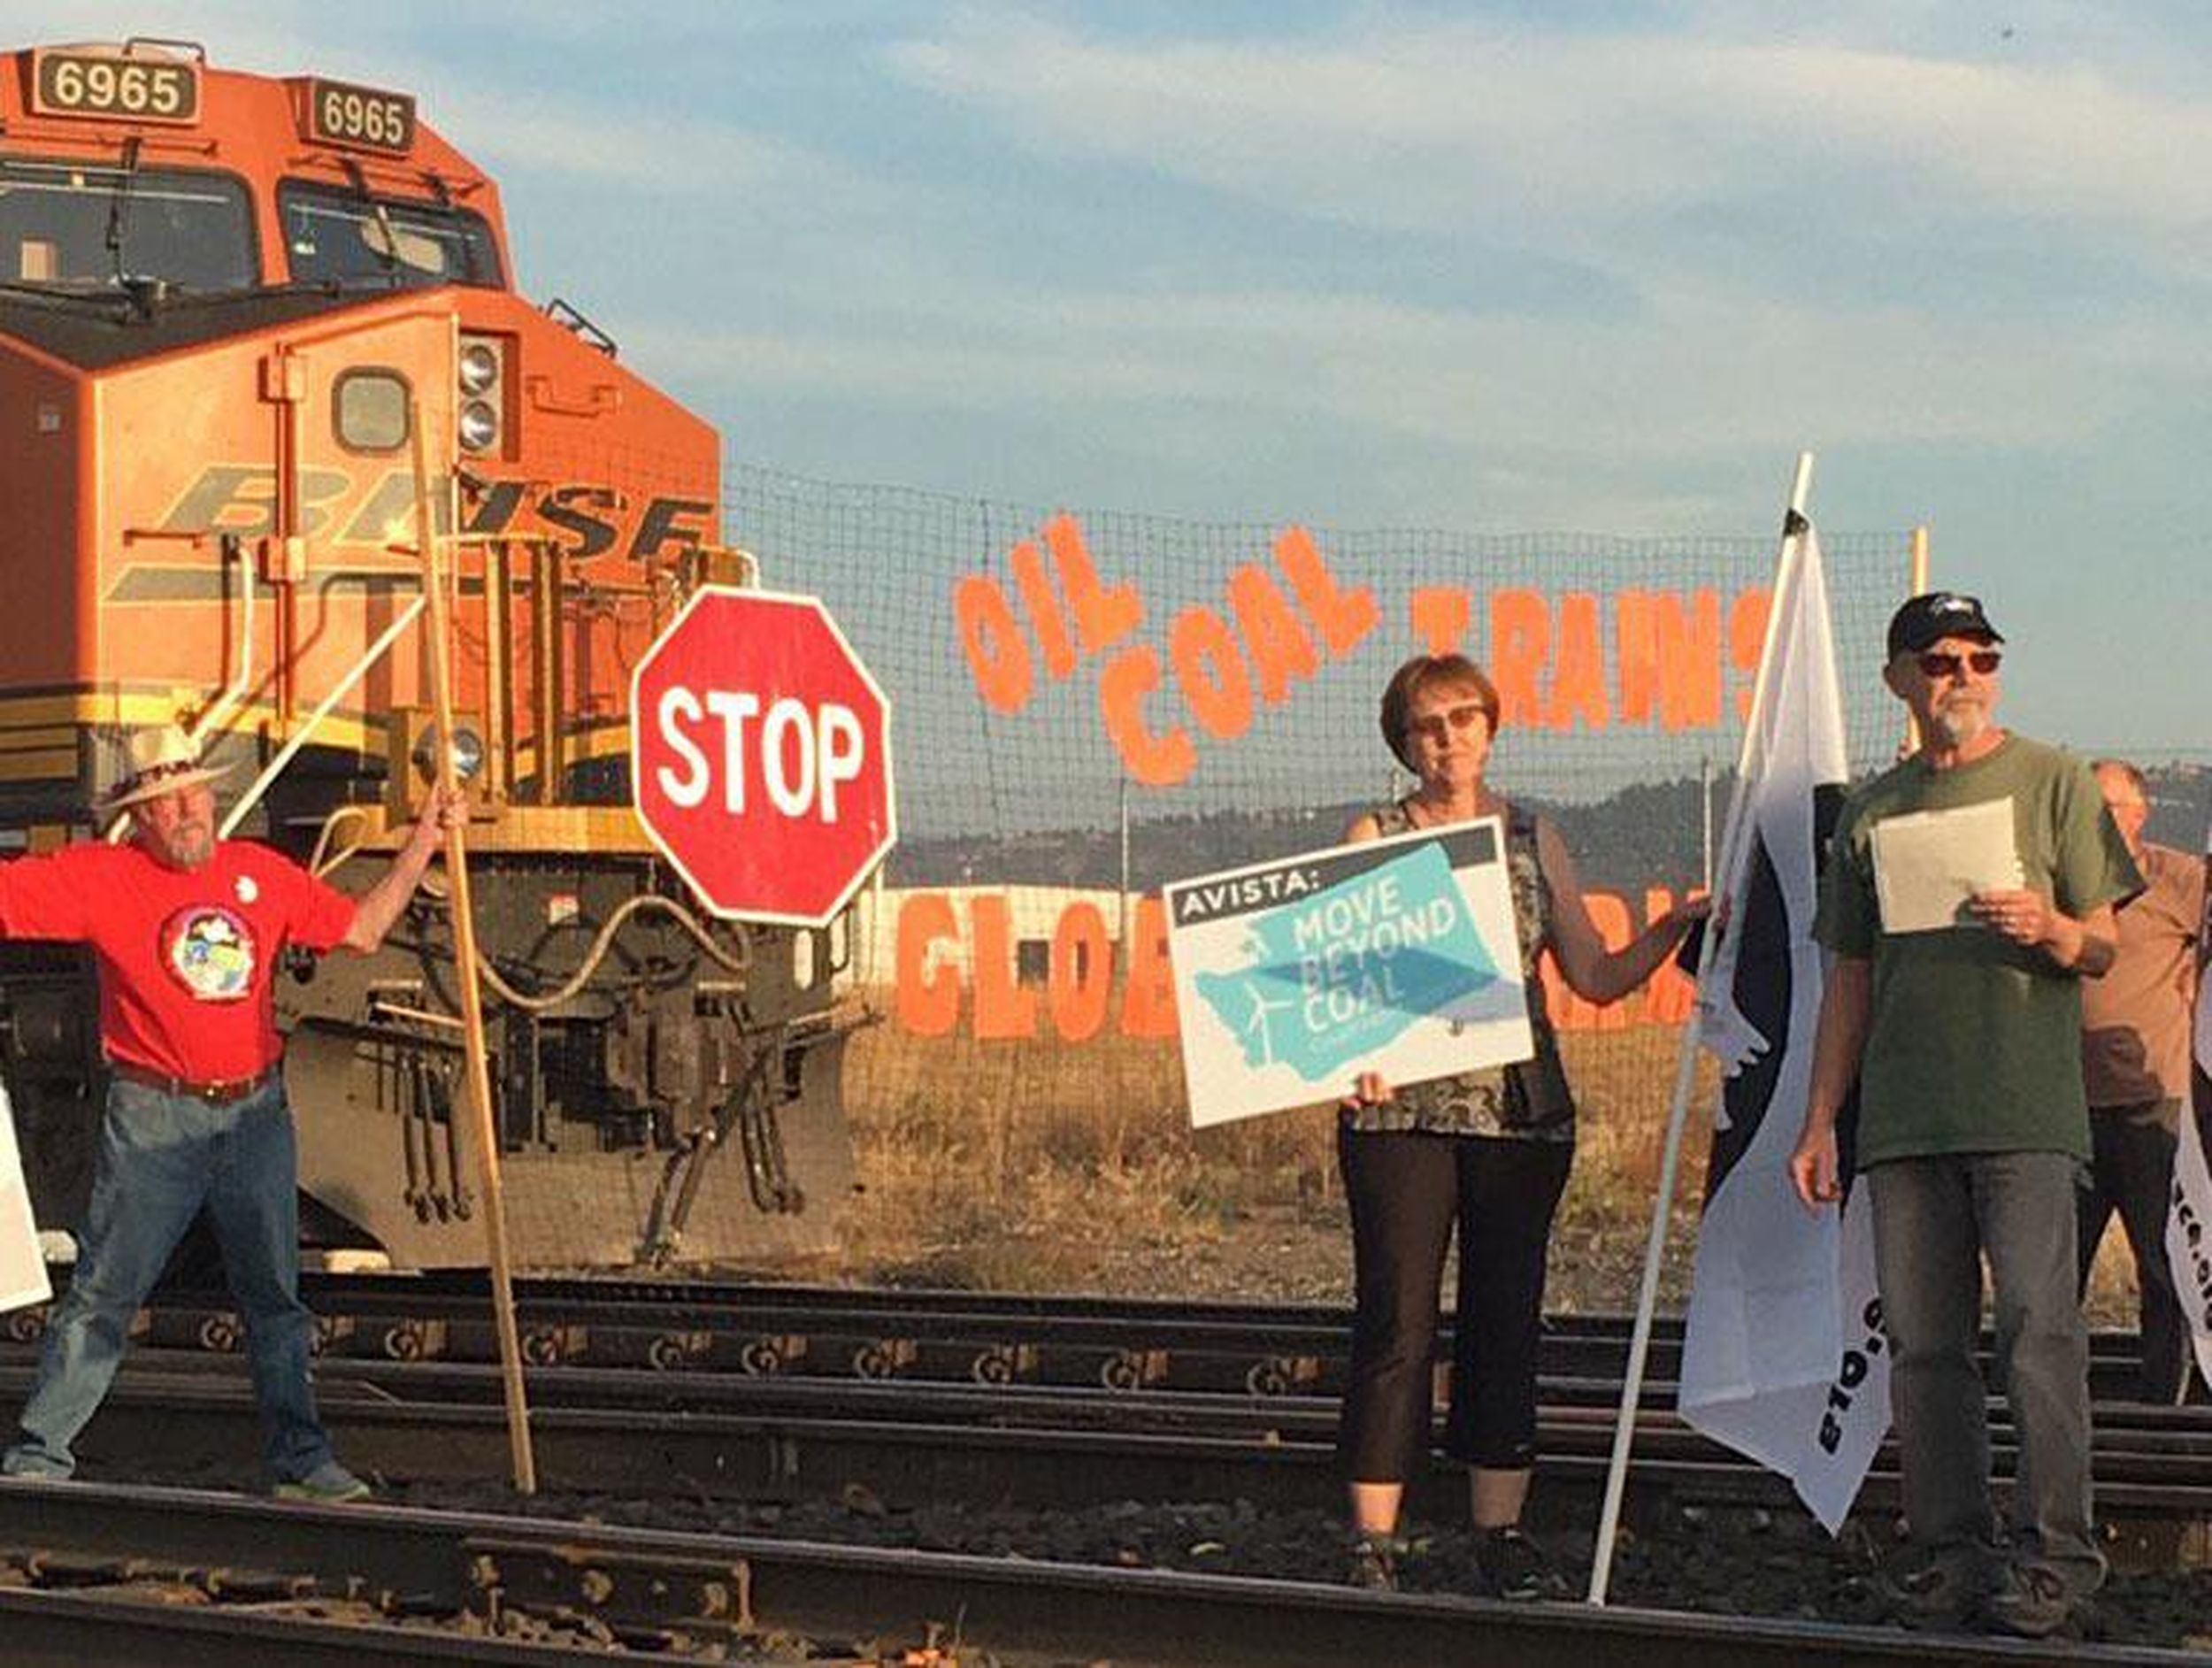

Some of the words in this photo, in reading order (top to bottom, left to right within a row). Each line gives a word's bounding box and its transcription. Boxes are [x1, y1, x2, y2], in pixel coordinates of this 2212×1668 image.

[54, 60, 180, 113] 6965
[324, 91, 404, 144] 6965
[157, 466, 715, 565] BNSF
[952, 509, 1142, 714] OIL
[1099, 523, 1382, 787] COAL
[657, 685, 864, 824] STOP
[1181, 868, 1321, 918] AVISTA:
[1294, 874, 1403, 951] MOVE
[1300, 896, 1456, 997] BEYOND
[1303, 965, 1407, 1034] COAL
